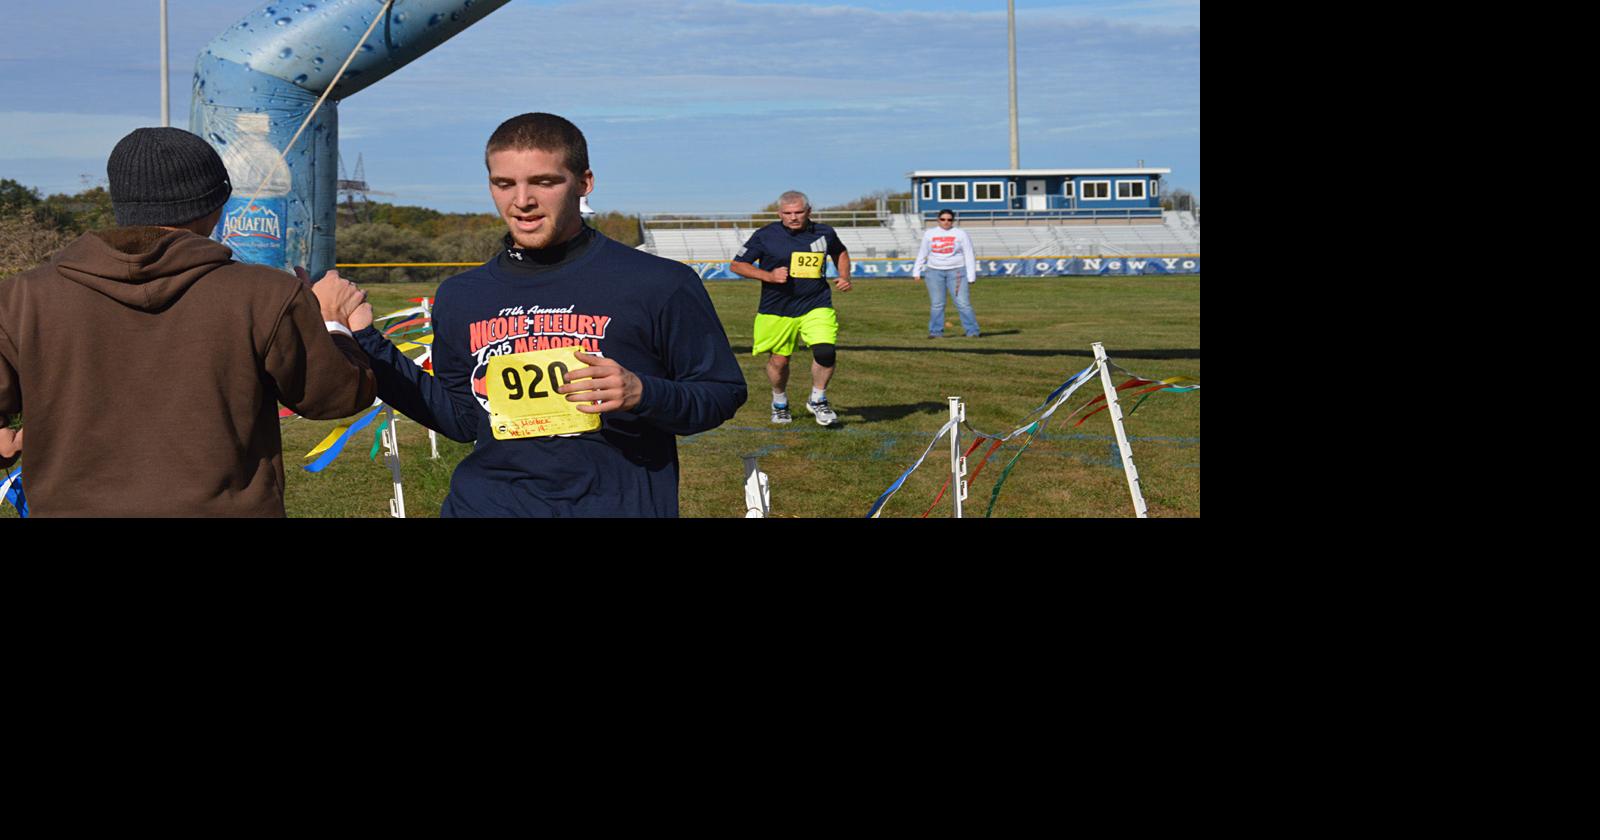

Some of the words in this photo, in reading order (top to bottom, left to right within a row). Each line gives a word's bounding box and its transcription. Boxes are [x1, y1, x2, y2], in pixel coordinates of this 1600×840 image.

[223, 212, 281, 238] AQUAFINA
[798, 256, 819, 267] 922
[1036, 259, 1066, 271] of
[1083, 259, 1147, 270] New
[498, 306, 524, 316] 17th
[526, 305, 575, 315] Annual
[469, 315, 529, 353] NICOLE
[533, 314, 611, 338] FLEURY
[514, 336, 600, 353] MEMORIAL
[501, 361, 571, 400] 920
